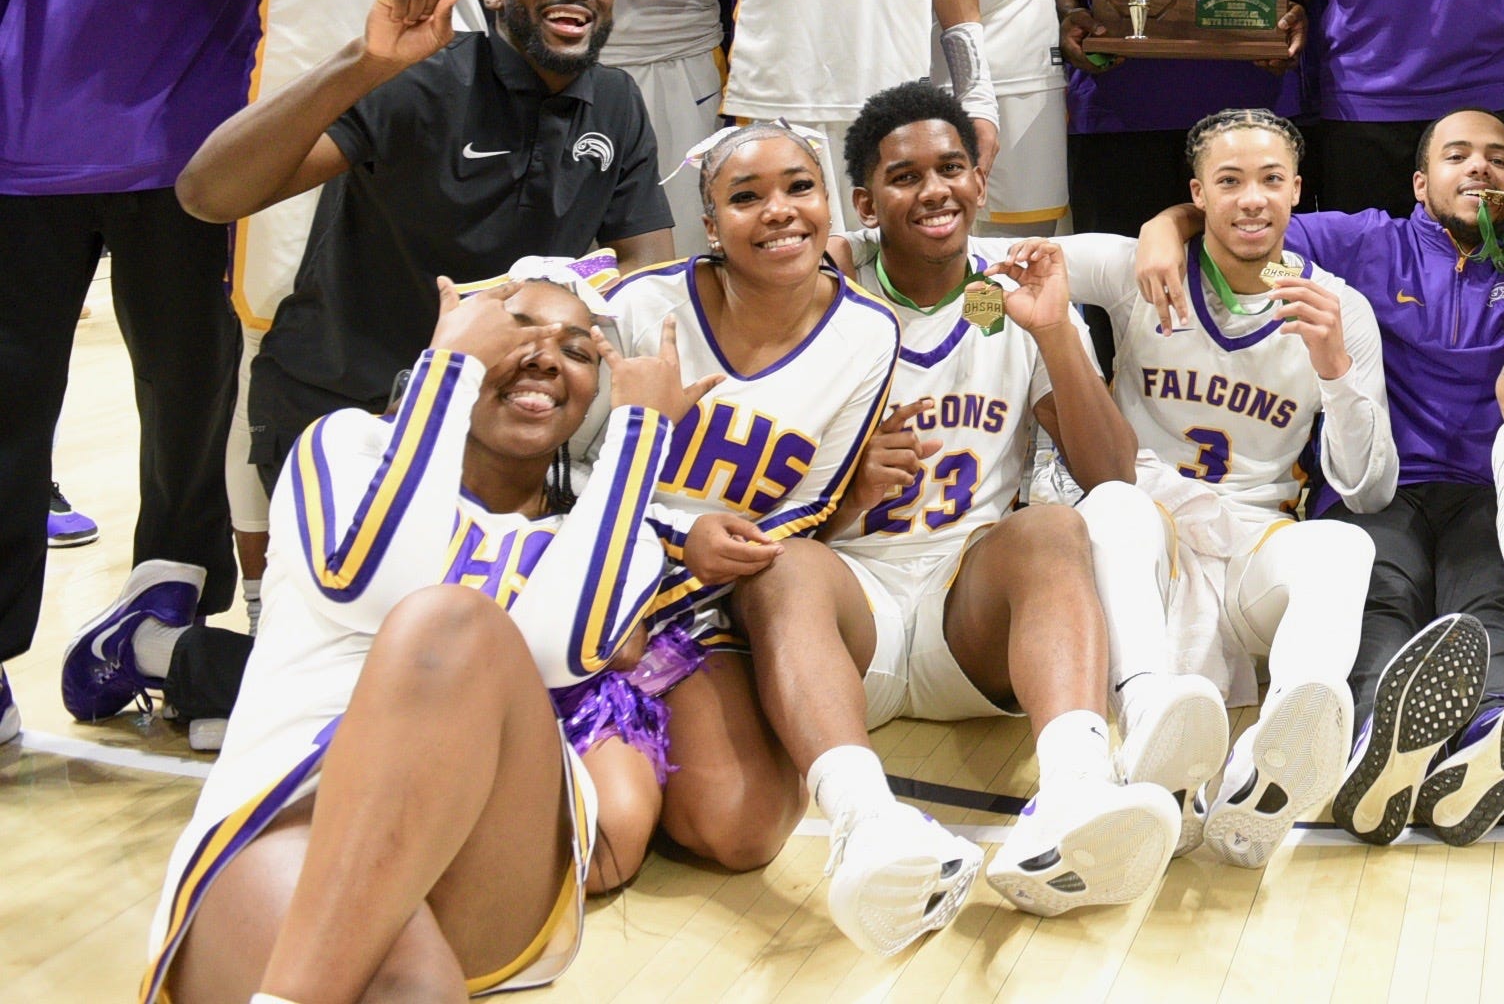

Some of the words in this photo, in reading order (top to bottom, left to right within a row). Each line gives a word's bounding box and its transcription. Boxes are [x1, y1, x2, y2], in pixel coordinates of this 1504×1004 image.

[964, 301, 1001, 314] OHSAA
[1142, 366, 1297, 430] FALCONS
[1177, 426, 1232, 485] 3
[860, 449, 982, 537] 23
